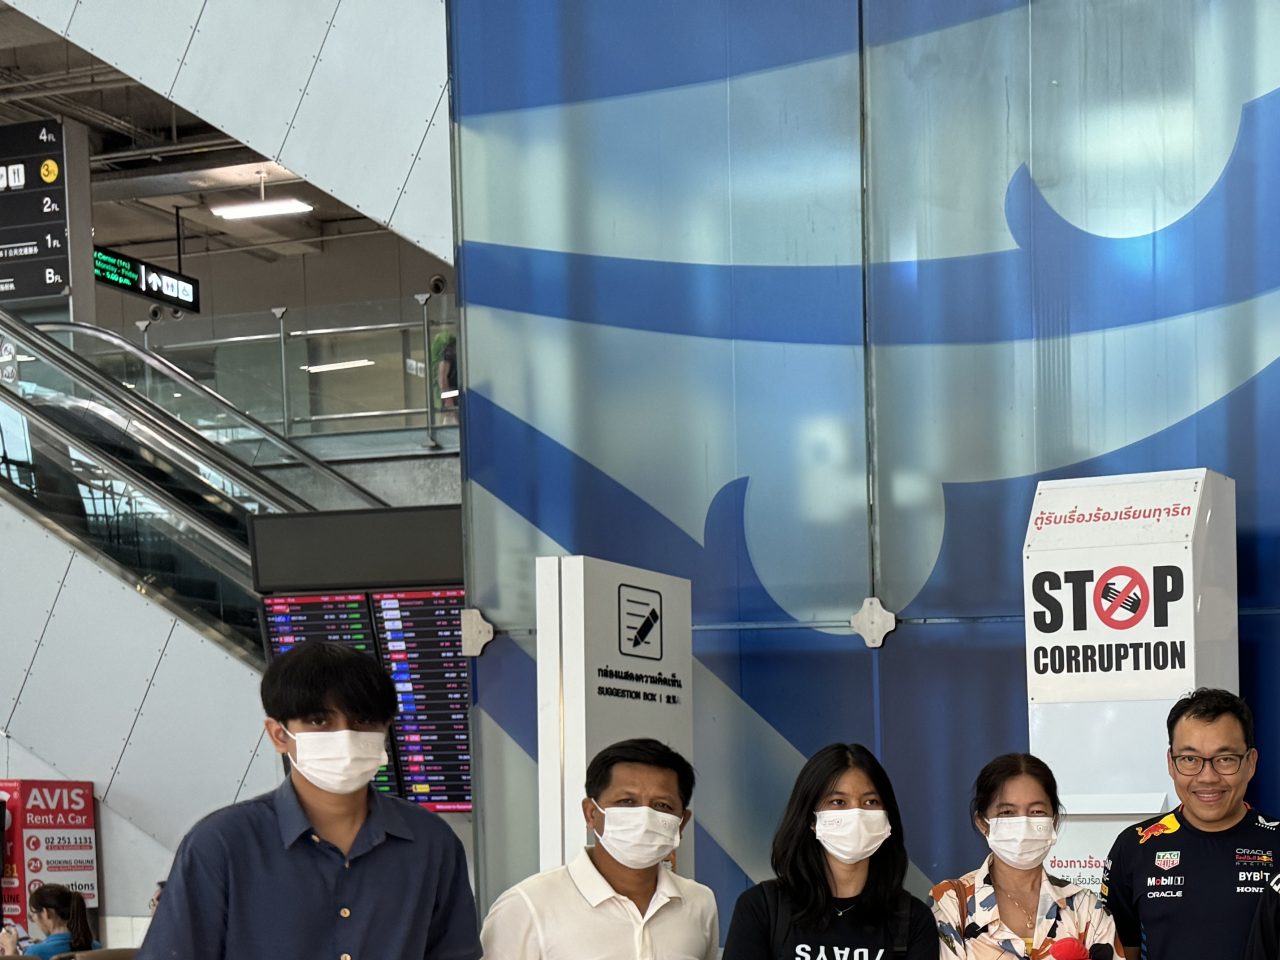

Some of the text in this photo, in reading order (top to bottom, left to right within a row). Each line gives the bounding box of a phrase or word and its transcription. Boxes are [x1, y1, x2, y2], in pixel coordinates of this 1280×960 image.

[1034, 503, 1192, 531] ตู้รับเรื่องร้องเรียนทุจริต
[1033, 640, 1186, 675] CORRUPTION
[597, 686, 641, 699] SUGGESTION
[25, 788, 85, 811] AVIS
[26, 813, 87, 824] Rent A Car
[45, 836, 92, 845] 02 251 1131
[1235, 848, 1273, 857] ORACLE
[1147, 876, 1173, 887] Mobil
[1238, 870, 1270, 882] BYBIT
[1147, 891, 1183, 899] ORACLE
